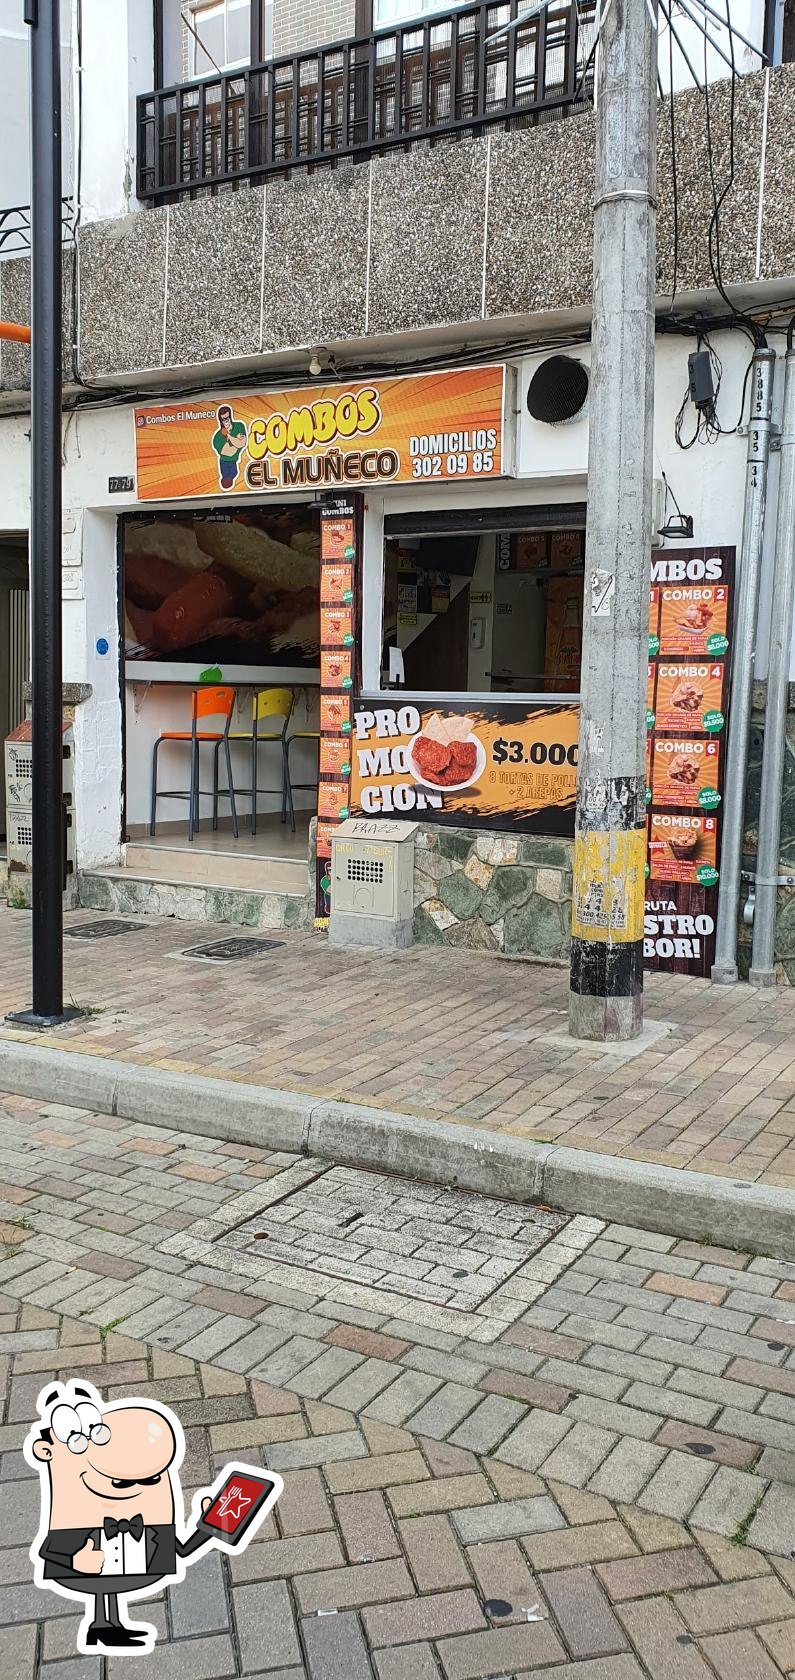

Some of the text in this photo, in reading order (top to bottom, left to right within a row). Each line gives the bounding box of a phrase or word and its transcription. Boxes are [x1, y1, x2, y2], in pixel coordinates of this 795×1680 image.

[146, 414, 176, 424] Combos
[177, 412, 184, 421] El
[248, 389, 380, 460] COMBOS
[409, 430, 497, 457] DOMICILIOS
[247, 449, 398, 486] EL MUÑECO
[412, 454, 494, 477] 302 09 85
[651, 558, 722, 581] MBOS
[663, 588, 725, 600] COMBO 2
[660, 666, 720, 677] COMBO 4
[354, 705, 421, 740] PRO
[655, 742, 704, 753] COMBO
[707, 743, 716, 754] 6
[357, 745, 412, 777] MO
[489, 771, 577, 787] 8 TORTAS DE POLL
[360, 783, 443, 813] CION
[517, 786, 524, 799] 2
[525, 787, 563, 800] AREPAS
[652, 816, 714, 829] COMBO 8
[644, 901, 677, 911] RUTA
[644, 914, 715, 936] STRO
[643, 937, 701, 959] BOR!
